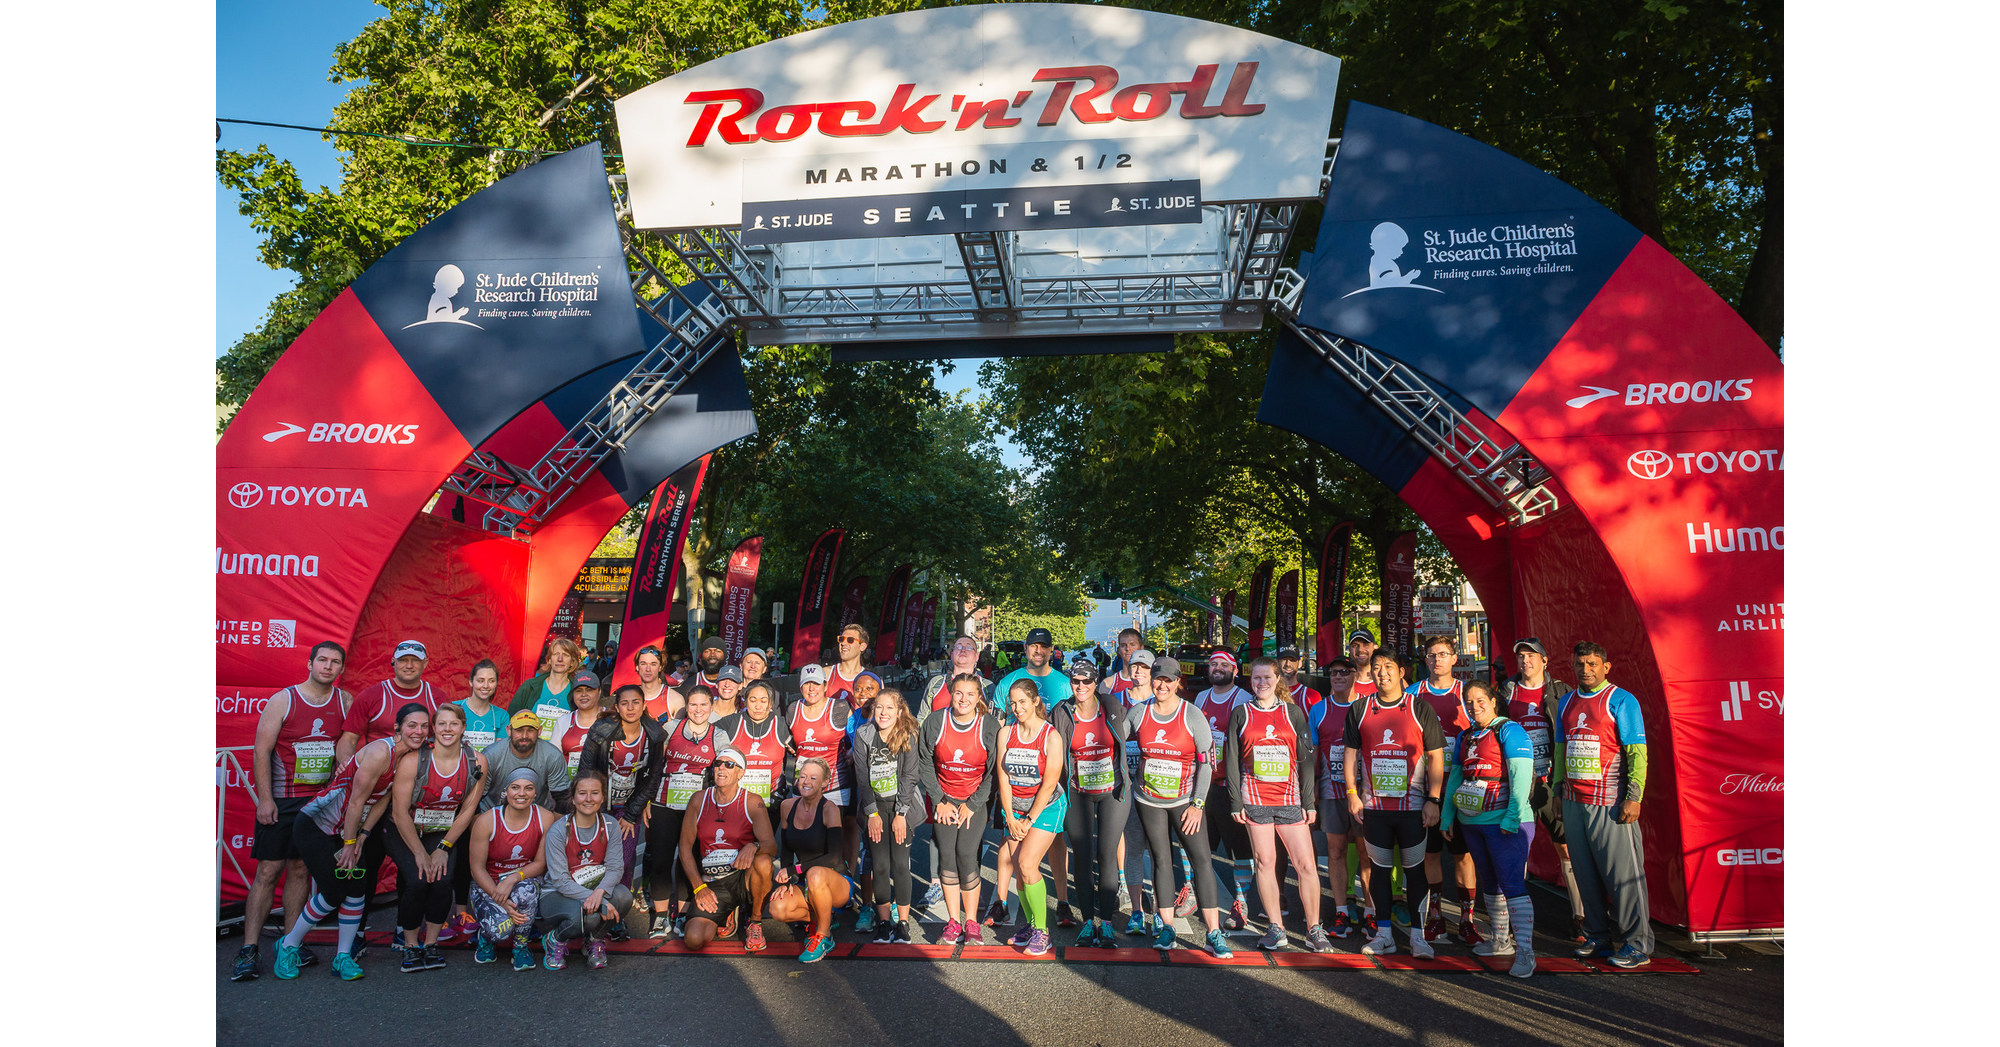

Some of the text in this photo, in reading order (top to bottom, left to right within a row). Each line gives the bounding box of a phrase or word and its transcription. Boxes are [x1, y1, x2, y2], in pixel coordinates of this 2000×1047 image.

[683, 83, 946, 148] Rock
[1032, 61, 1266, 127] Roll
[805, 153, 1132, 184] MARATHON & 1/2
[1129, 195, 1195, 210] ST. JUDE
[863, 199, 1071, 224] SEATTLE
[771, 213, 833, 228] ST. JUDE
[1423, 223, 1575, 248] St. Jude Children's
[1425, 240, 1578, 263] Research Hospital
[1433, 262, 1574, 281] Finding cures. Saving children.
[475, 271, 600, 290] St. Jude Children's
[474, 287, 598, 306] Research Hospital
[477, 307, 592, 319] Finding cures. Saving children.
[1624, 378, 1754, 406] BROOKS
[307, 422, 420, 445] BROOKS
[1676, 449, 1784, 475] TOYOT
[267, 485, 369, 508] TOYOTA
[639, 542, 661, 593] Rock
[657, 483, 679, 525] Roll
[655, 492, 686, 588] MARATHON SERIES
[590, 566, 608, 574] BETH
[610, 566, 618, 574] IS
[579, 575, 619, 583] POSSIBLE
[724, 585, 739, 622] Saving
[736, 587, 750, 626] Finding
[1386, 583, 1400, 620] Saving
[1398, 584, 1412, 625] Finding
[216, 634, 262, 645] INES
[1584, 733, 1600, 741] HERO
[673, 751, 692, 761] Jude
[692, 755, 711, 764] Hero
[1096, 747, 1110, 755] HERO
[1443, 753, 1452, 762] 8
[300, 758, 330, 769] 5852
[1008, 764, 1037, 775] 21172
[1260, 762, 1284, 772] 9119
[1331, 762, 1344, 770] 20
[1566, 758, 1600, 769] 10096
[570, 768, 577, 777] 5
[1083, 773, 1110, 783] 5853
[875, 775, 898, 789] 479
[1149, 775, 1177, 786] 7232
[1375, 776, 1403, 786] 7239
[673, 790, 695, 799] 722
[1456, 793, 1479, 807] 9199
[1716, 847, 1784, 866] GEIC
